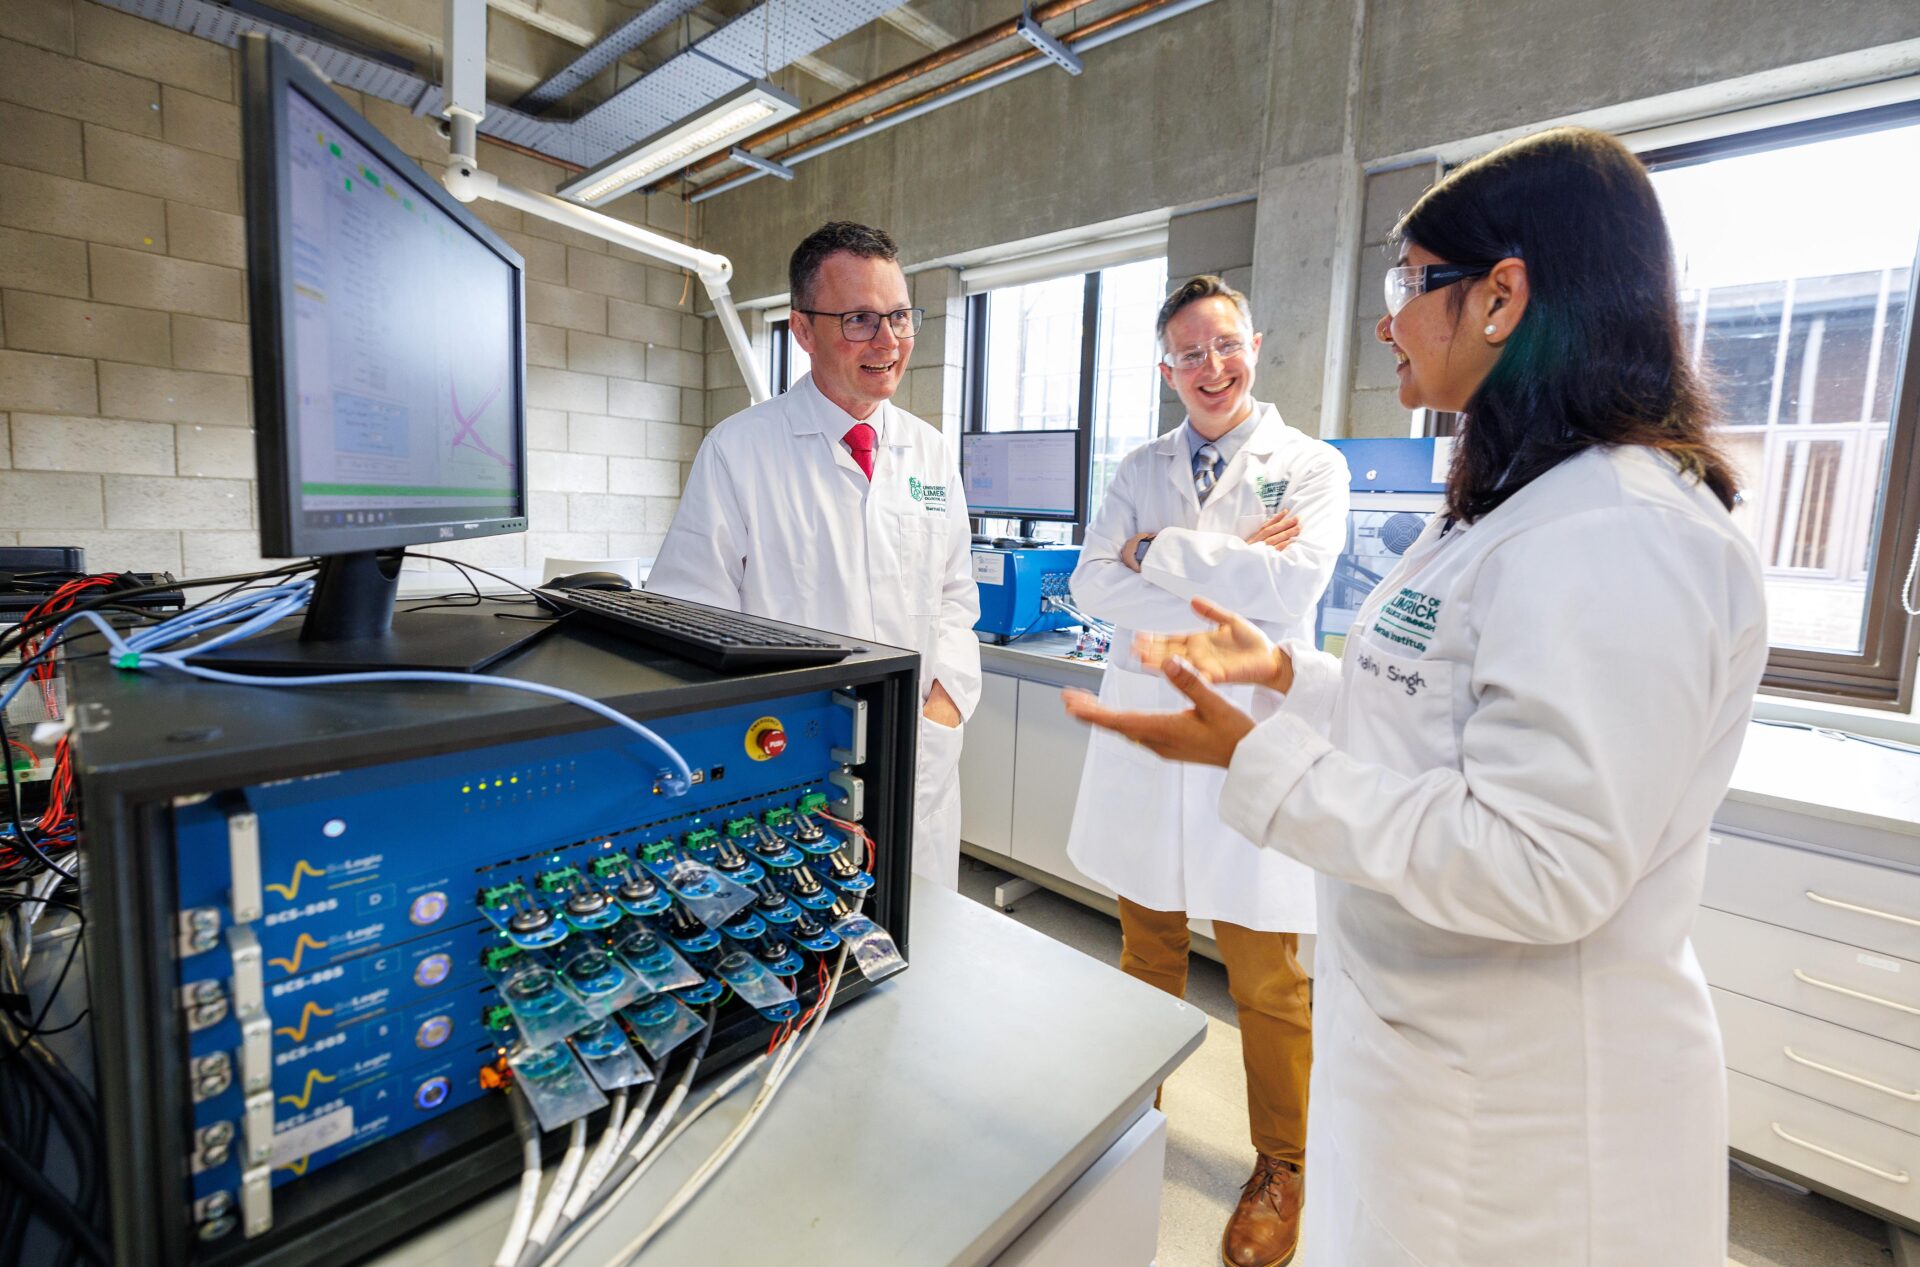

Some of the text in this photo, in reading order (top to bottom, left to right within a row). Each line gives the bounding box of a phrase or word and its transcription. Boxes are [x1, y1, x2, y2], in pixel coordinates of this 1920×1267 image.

[1428, 597, 1441, 607] OF
[1387, 665, 1427, 695] Singh
[369, 893, 382, 907] D
[374, 957, 387, 972] C
[376, 1088, 388, 1101] A
[353, 1115, 390, 1135] Logic
